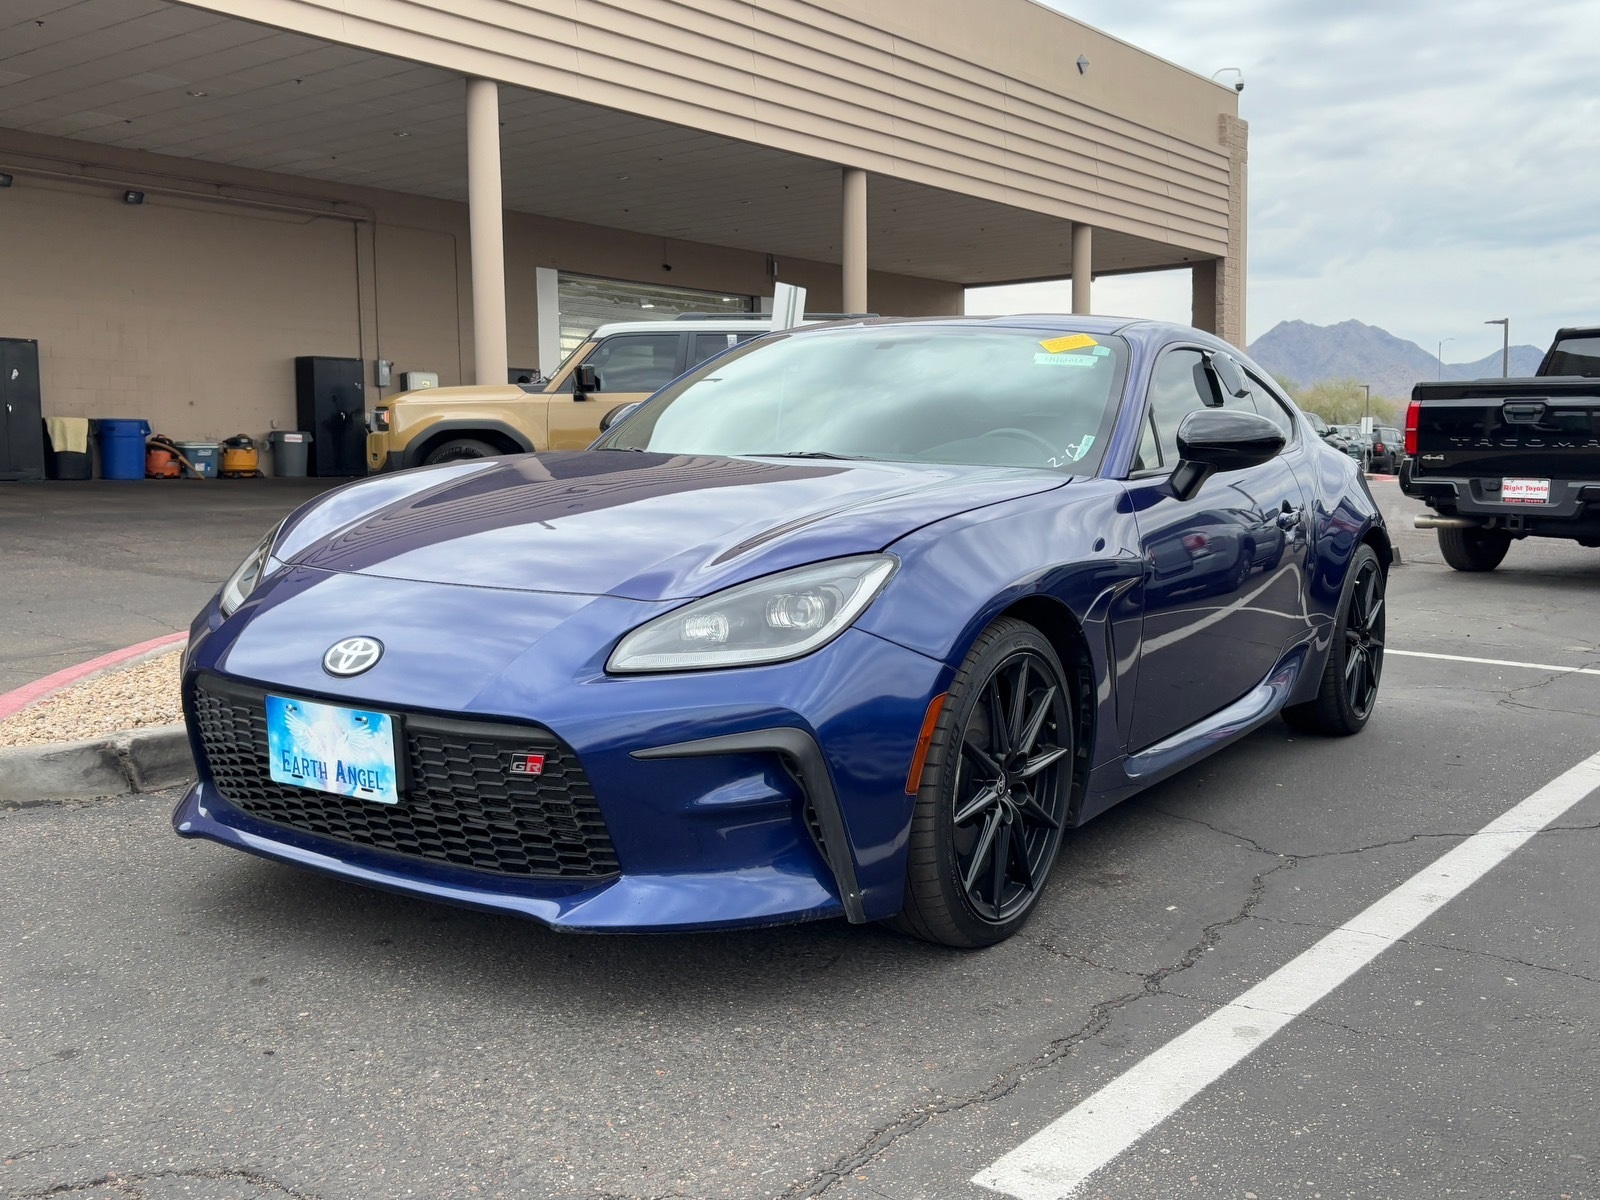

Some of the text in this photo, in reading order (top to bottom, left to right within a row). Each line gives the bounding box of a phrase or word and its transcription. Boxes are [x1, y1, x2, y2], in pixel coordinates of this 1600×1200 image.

[1450, 437, 1600, 448] TACOMA
[1503, 484, 1523, 492] Right
[282, 749, 384, 790] EARTH ANGEL
[512, 761, 542, 773] GR
